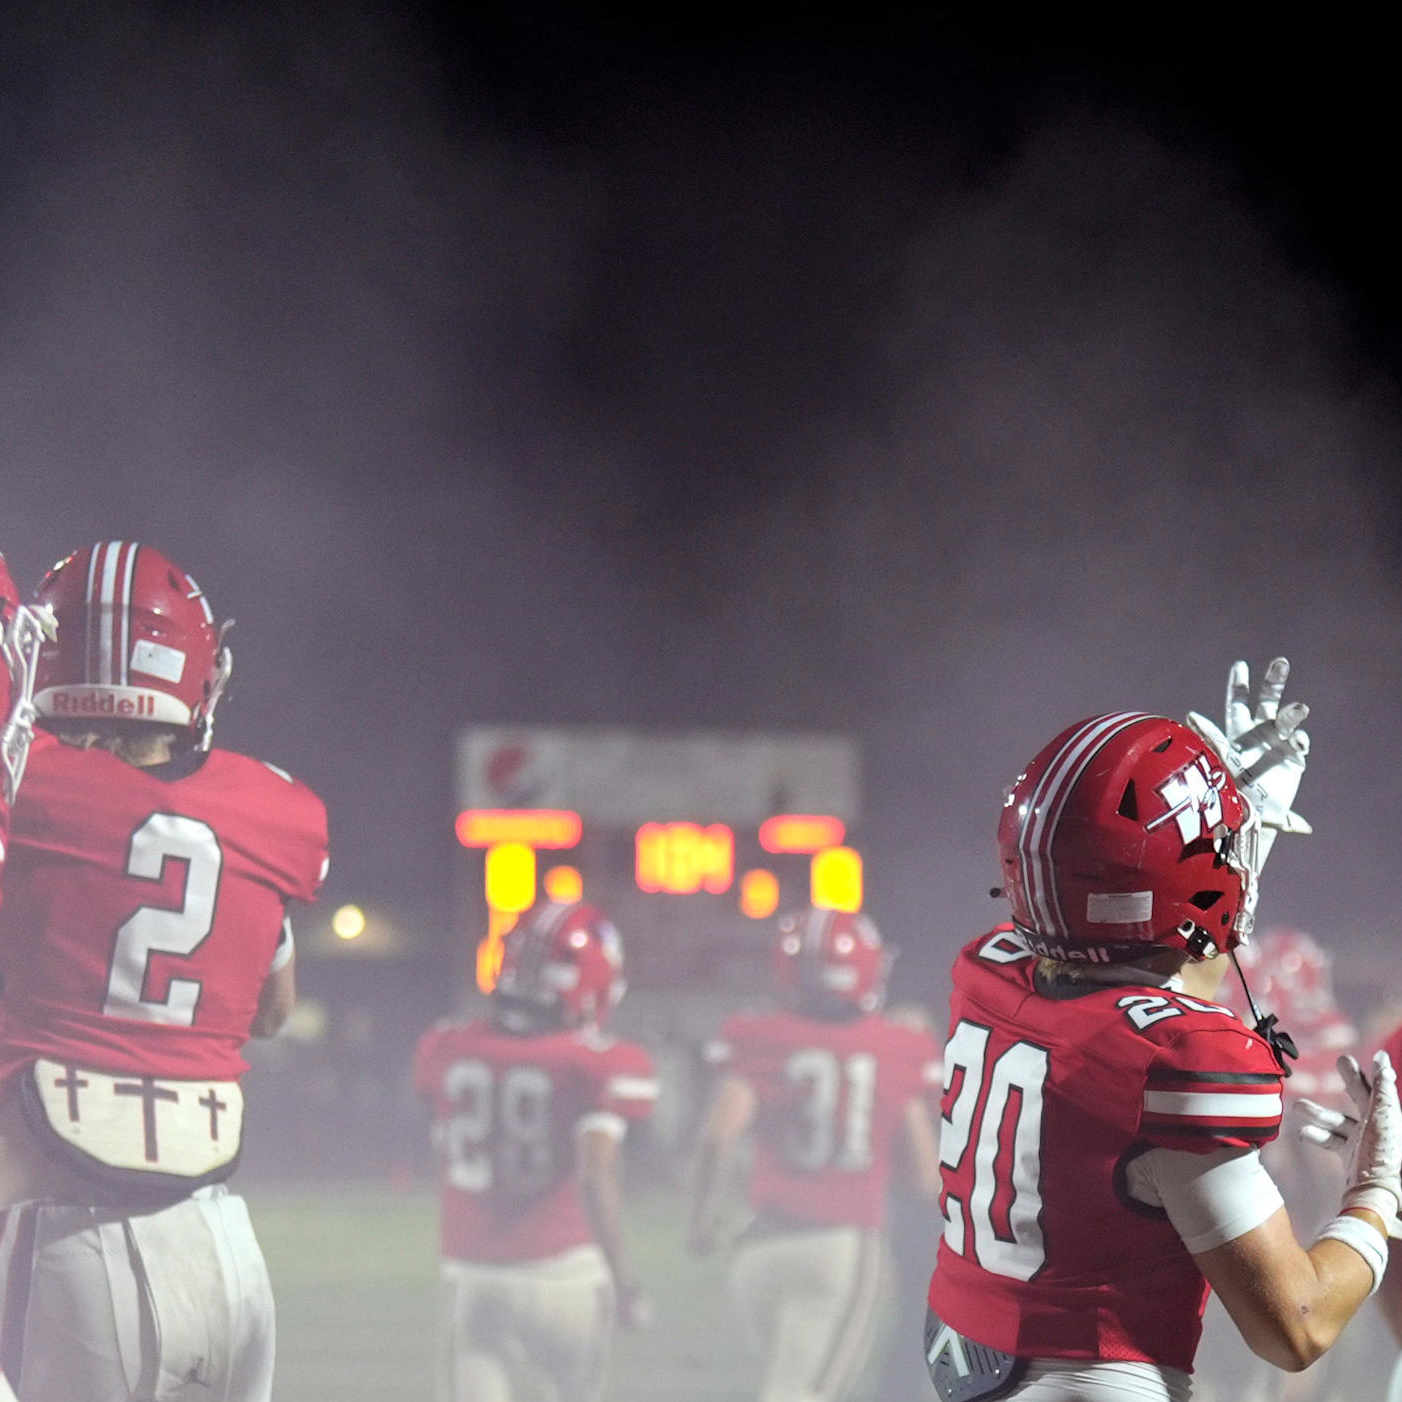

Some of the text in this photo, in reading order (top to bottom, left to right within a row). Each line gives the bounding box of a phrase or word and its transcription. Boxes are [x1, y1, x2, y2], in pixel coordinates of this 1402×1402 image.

[52, 690, 155, 717] Riddell
[104, 812, 222, 1027] 2
[784, 1046, 879, 1170] 31
[939, 1018, 1051, 1283] 20
